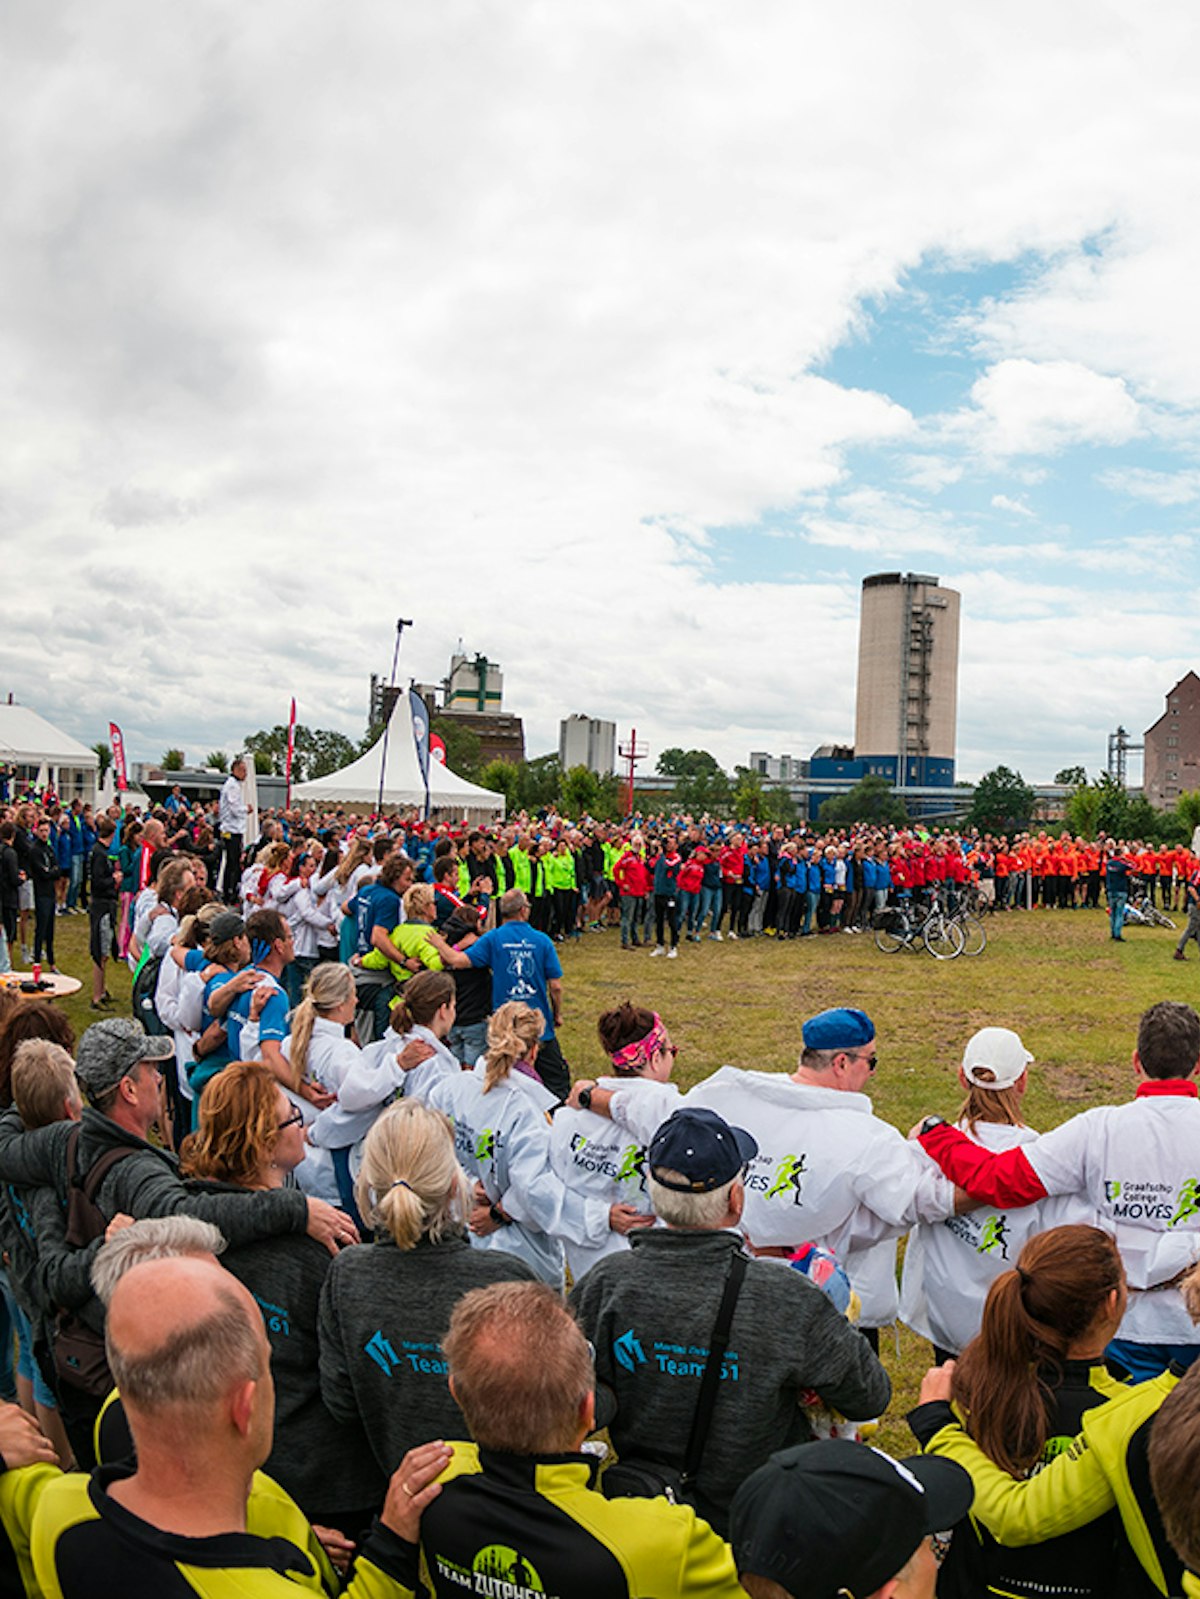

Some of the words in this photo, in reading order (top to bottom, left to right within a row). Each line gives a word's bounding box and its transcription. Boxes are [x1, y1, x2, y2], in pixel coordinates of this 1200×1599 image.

[574, 1154, 618, 1178] MOVES
[1123, 1181, 1173, 1194] Graafschap
[1123, 1193, 1158, 1204] College
[1114, 1203, 1173, 1219] MOVES
[269, 1316, 289, 1336] 61
[406, 1354, 448, 1375] Tea
[437, 1561, 472, 1589] TEAM
